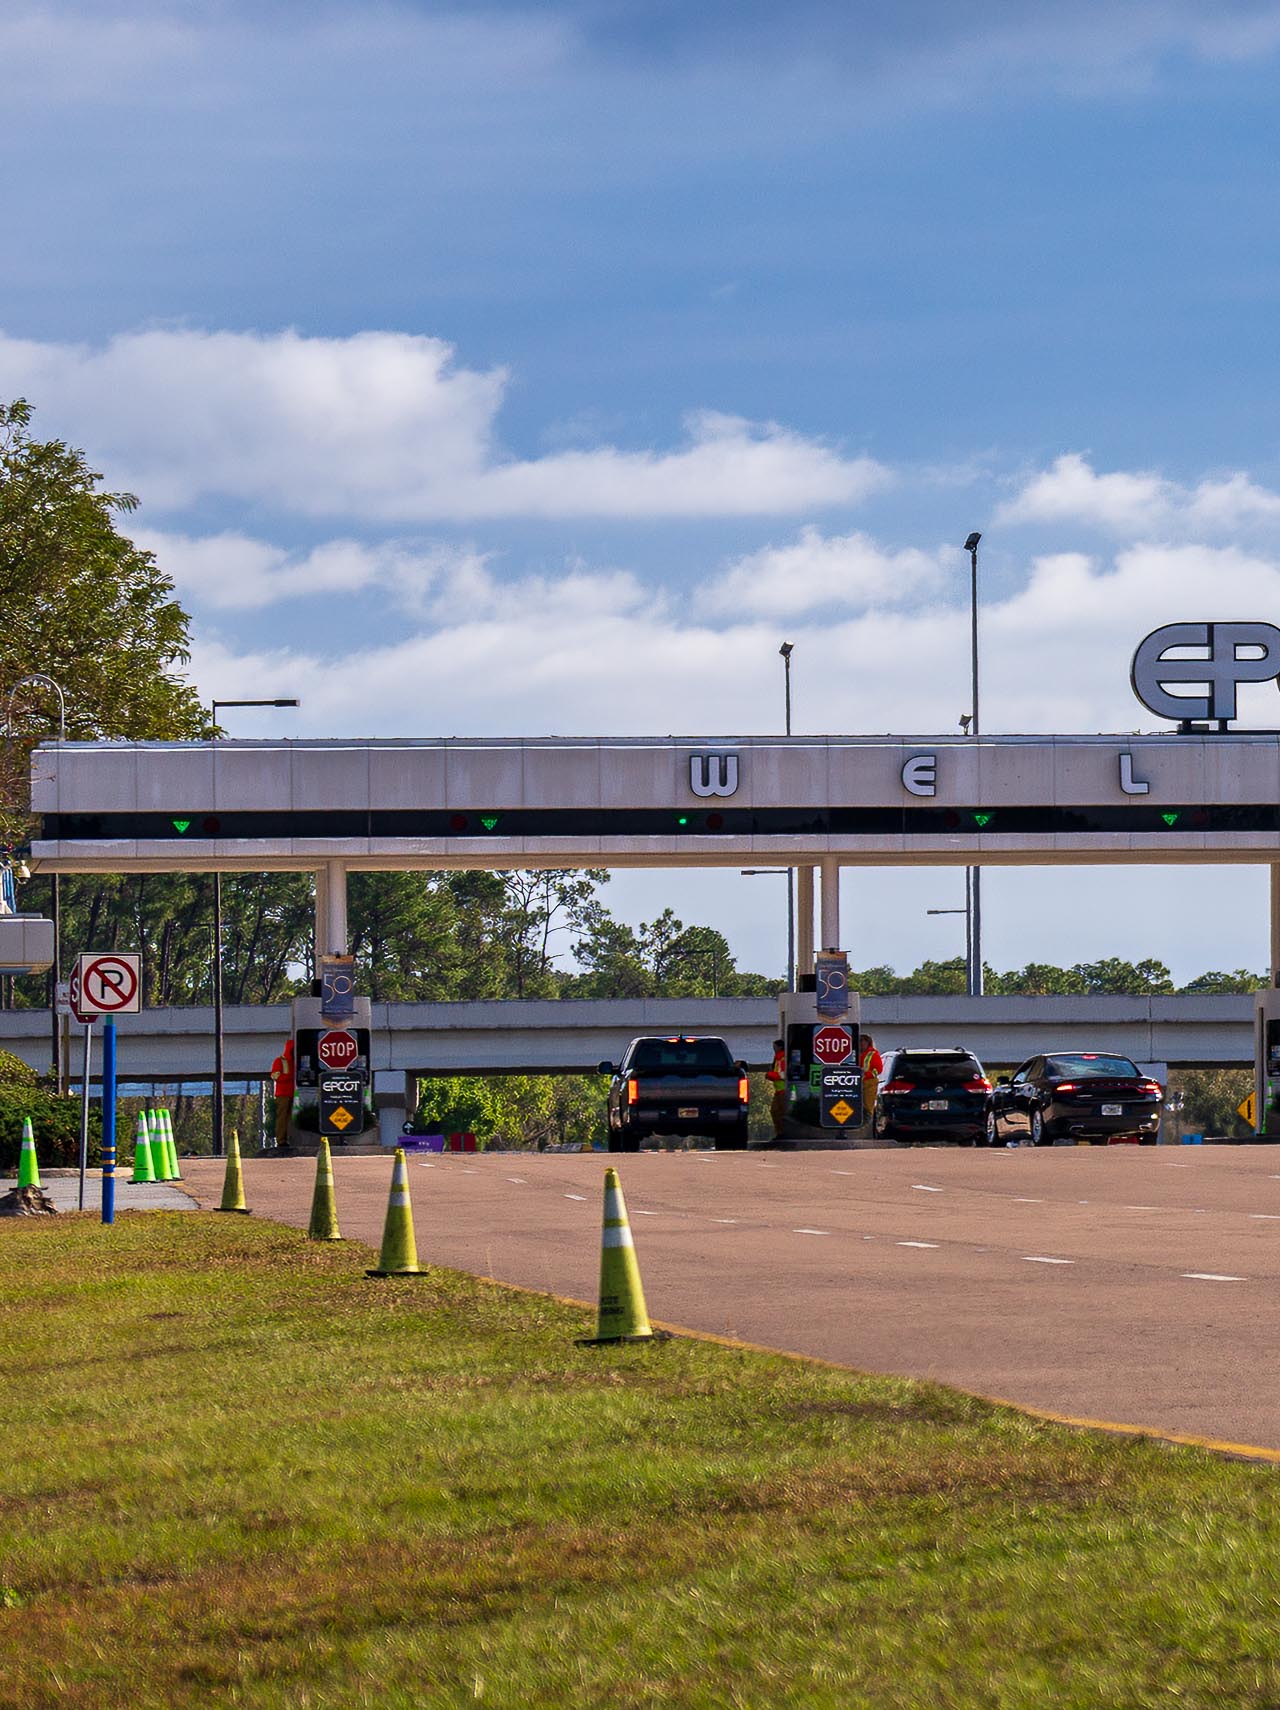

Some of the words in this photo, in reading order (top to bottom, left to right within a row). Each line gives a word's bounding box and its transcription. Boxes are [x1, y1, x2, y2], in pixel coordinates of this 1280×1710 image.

[323, 973, 353, 1004] 50
[818, 969, 846, 999] 50
[321, 1042, 355, 1058] STOP
[816, 1038, 849, 1053] STOP
[322, 1080, 360, 1092] EPCOT
[823, 1075, 861, 1086] EPCOT
